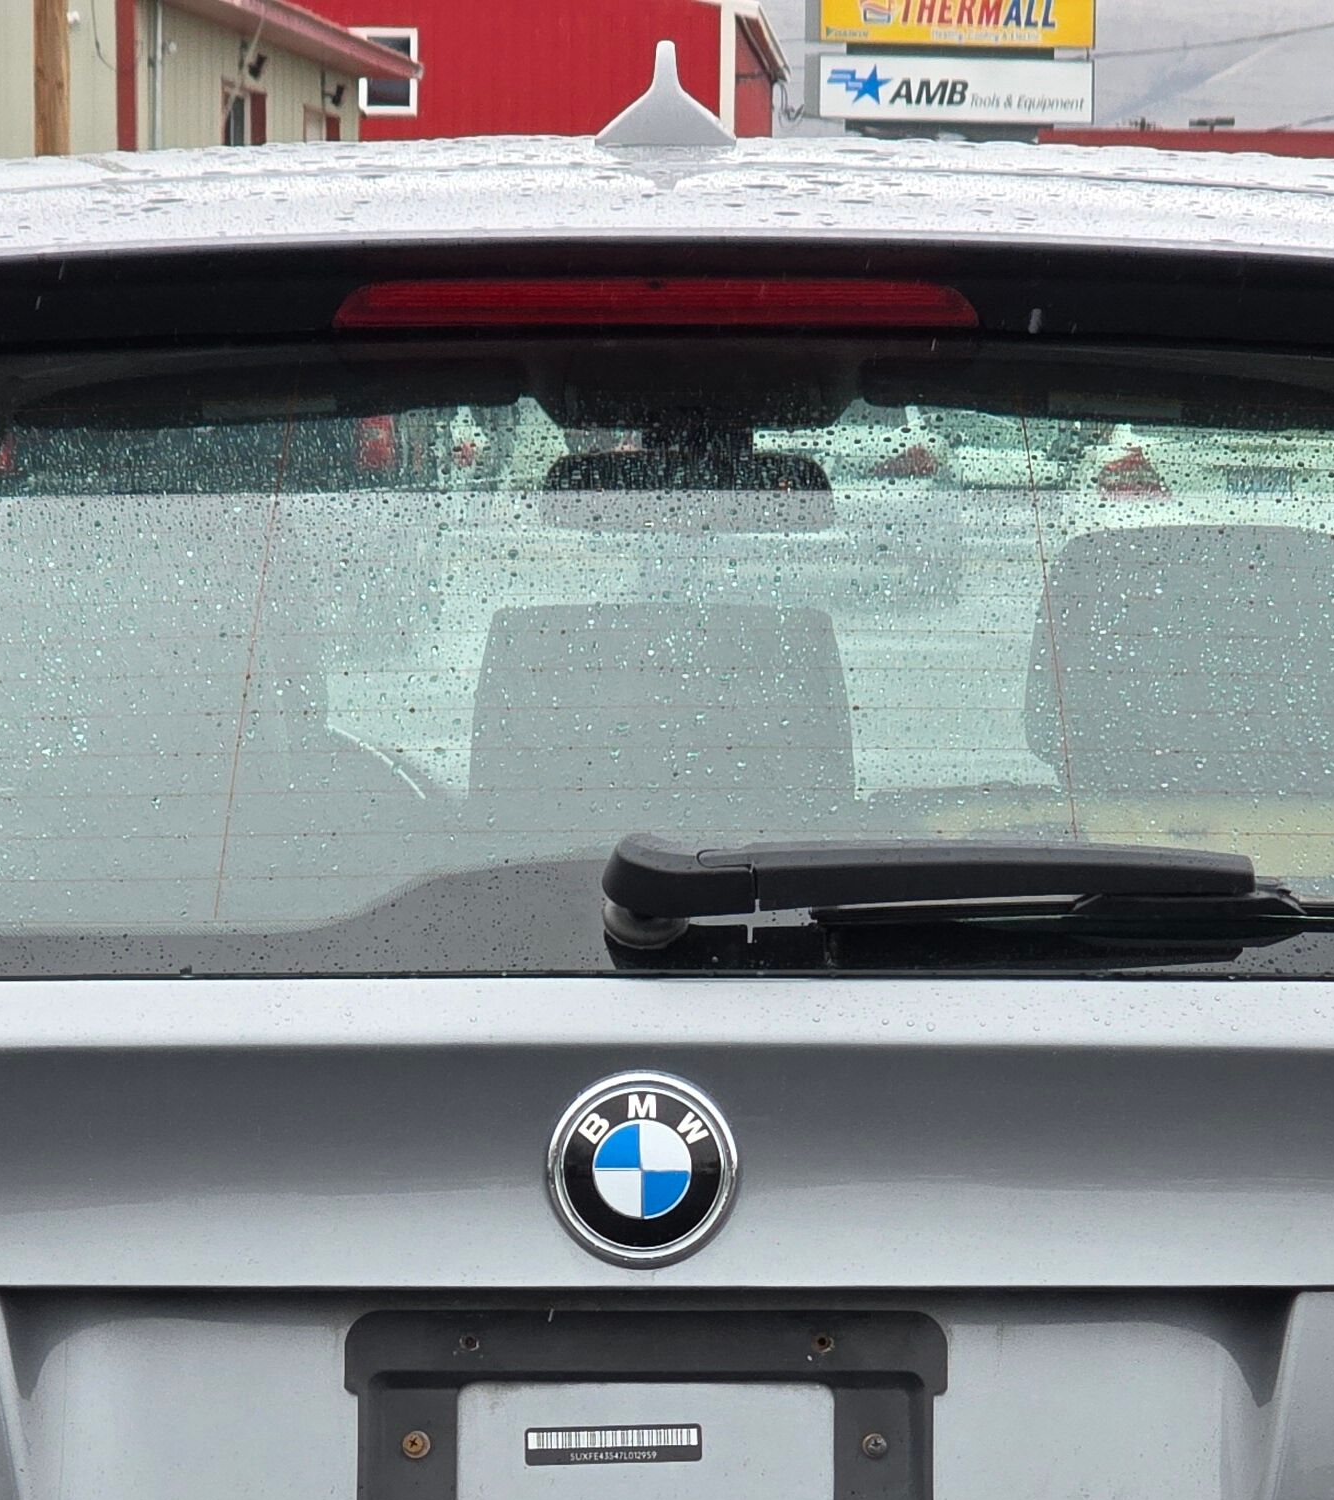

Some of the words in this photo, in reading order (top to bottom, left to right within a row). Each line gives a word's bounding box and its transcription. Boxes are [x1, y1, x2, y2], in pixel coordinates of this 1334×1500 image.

[900, 0, 1056, 27] THERMALL
[889, 78, 969, 106] AMB
[970, 93, 1000, 109] Tools
[1003, 95, 1012, 109] &
[1017, 94, 1085, 113] Equipment
[578, 1093, 709, 1145] BMW
